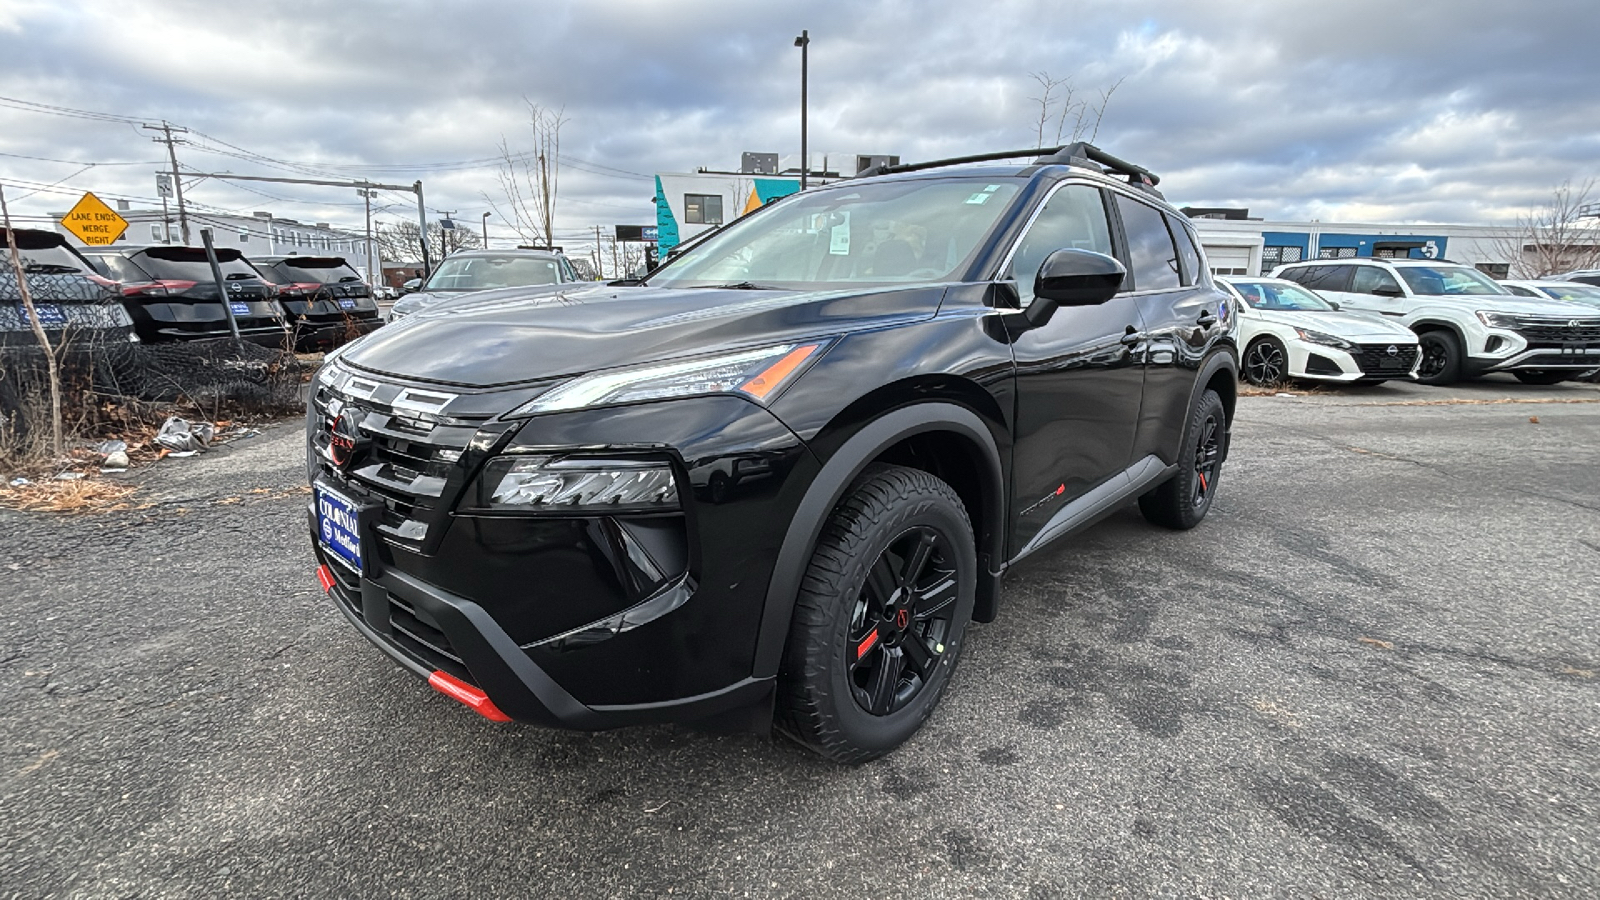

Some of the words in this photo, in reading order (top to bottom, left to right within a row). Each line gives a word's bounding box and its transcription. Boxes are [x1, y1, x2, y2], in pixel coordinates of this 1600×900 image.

[71, 212, 93, 221] LANE
[95, 212, 117, 222] ENDS
[82, 224, 111, 234] MERGE
[86, 236, 110, 245] RIGHT
[319, 497, 361, 539] COLONIAL
[333, 526, 361, 558] Medford
